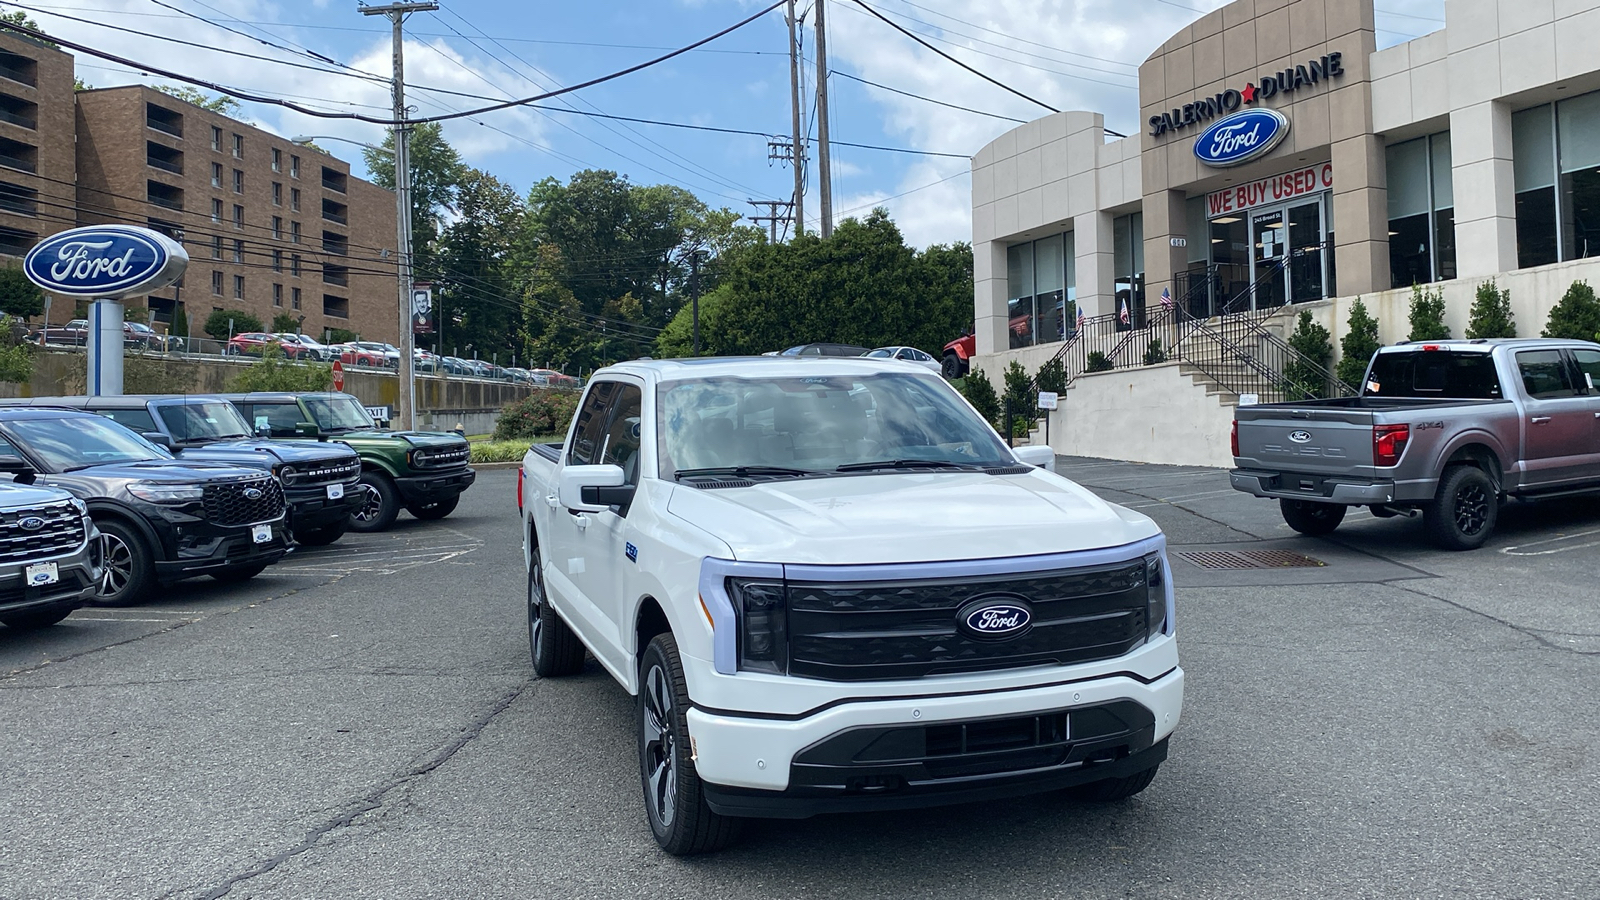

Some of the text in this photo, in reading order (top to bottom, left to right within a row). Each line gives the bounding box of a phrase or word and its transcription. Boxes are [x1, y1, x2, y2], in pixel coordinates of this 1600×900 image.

[1149, 51, 1345, 137] SALERNO DUANE
[1210, 121, 1261, 158] Ford
[1208, 189, 1233, 215] WE
[1236, 180, 1268, 209] BUY
[1272, 168, 1316, 200] USED
[51, 240, 136, 282] Ford
[332, 370, 344, 382] STOP
[434, 451, 465, 459] BRONCO
[1260, 444, 1347, 458] F-150
[308, 466, 351, 476] BRONCO
[978, 609, 1020, 629] Ford
